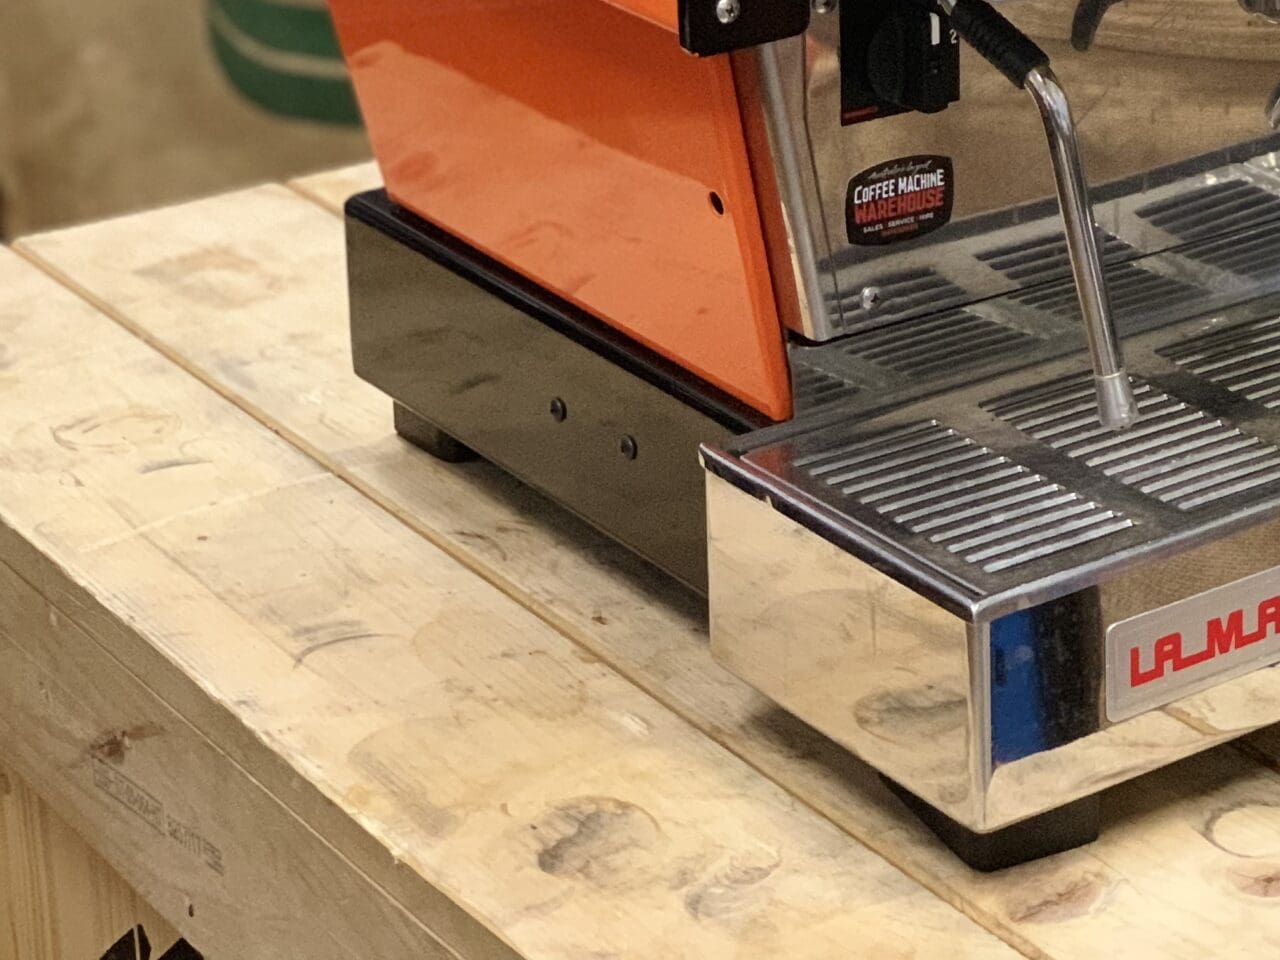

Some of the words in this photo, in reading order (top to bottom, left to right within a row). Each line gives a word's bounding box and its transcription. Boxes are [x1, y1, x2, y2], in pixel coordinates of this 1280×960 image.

[950, 29, 957, 44] 2
[854, 178, 895, 204] COFFEE
[898, 169, 945, 195] MACHINE
[854, 186, 945, 224] WAREHOUSE
[863, 223, 884, 233] SALES
